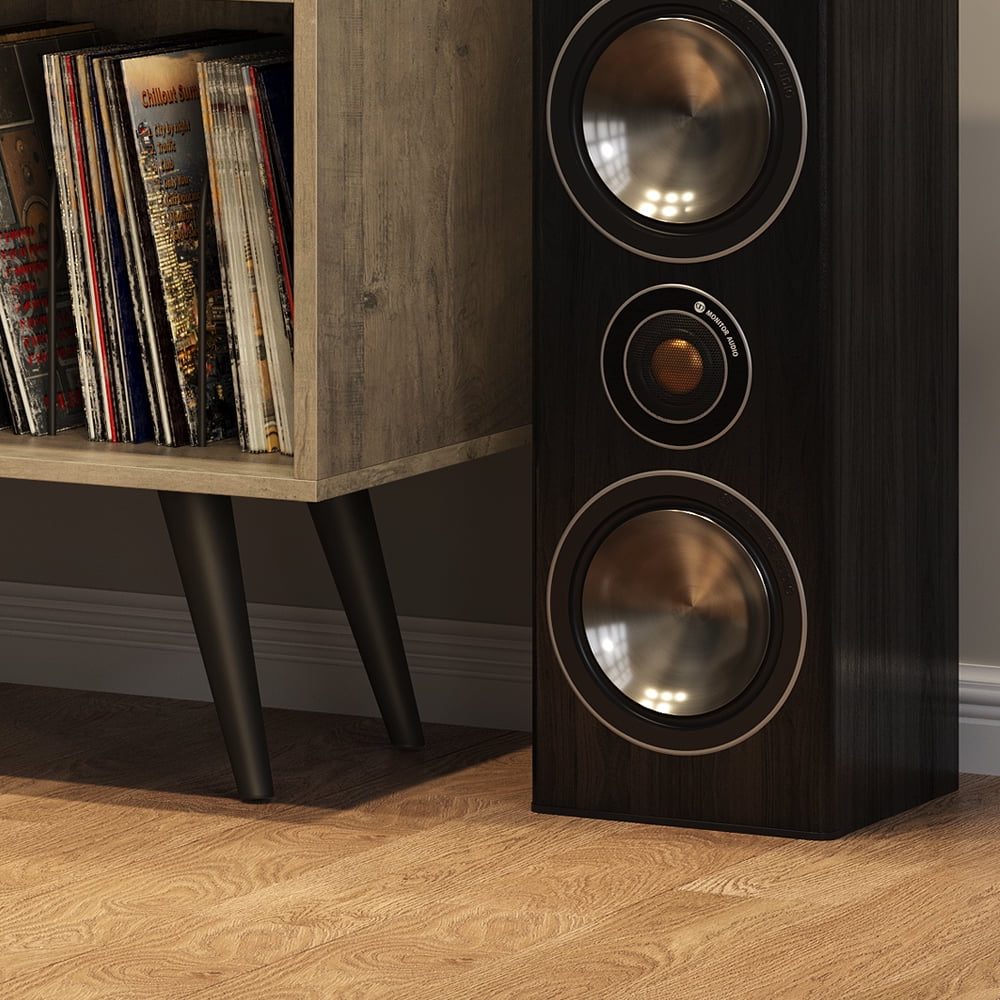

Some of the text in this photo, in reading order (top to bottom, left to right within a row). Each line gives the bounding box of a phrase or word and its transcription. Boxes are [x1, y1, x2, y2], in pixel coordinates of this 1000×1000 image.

[141, 86, 178, 108] Chillout
[705, 309, 739, 358] MONITOR AUDIO
